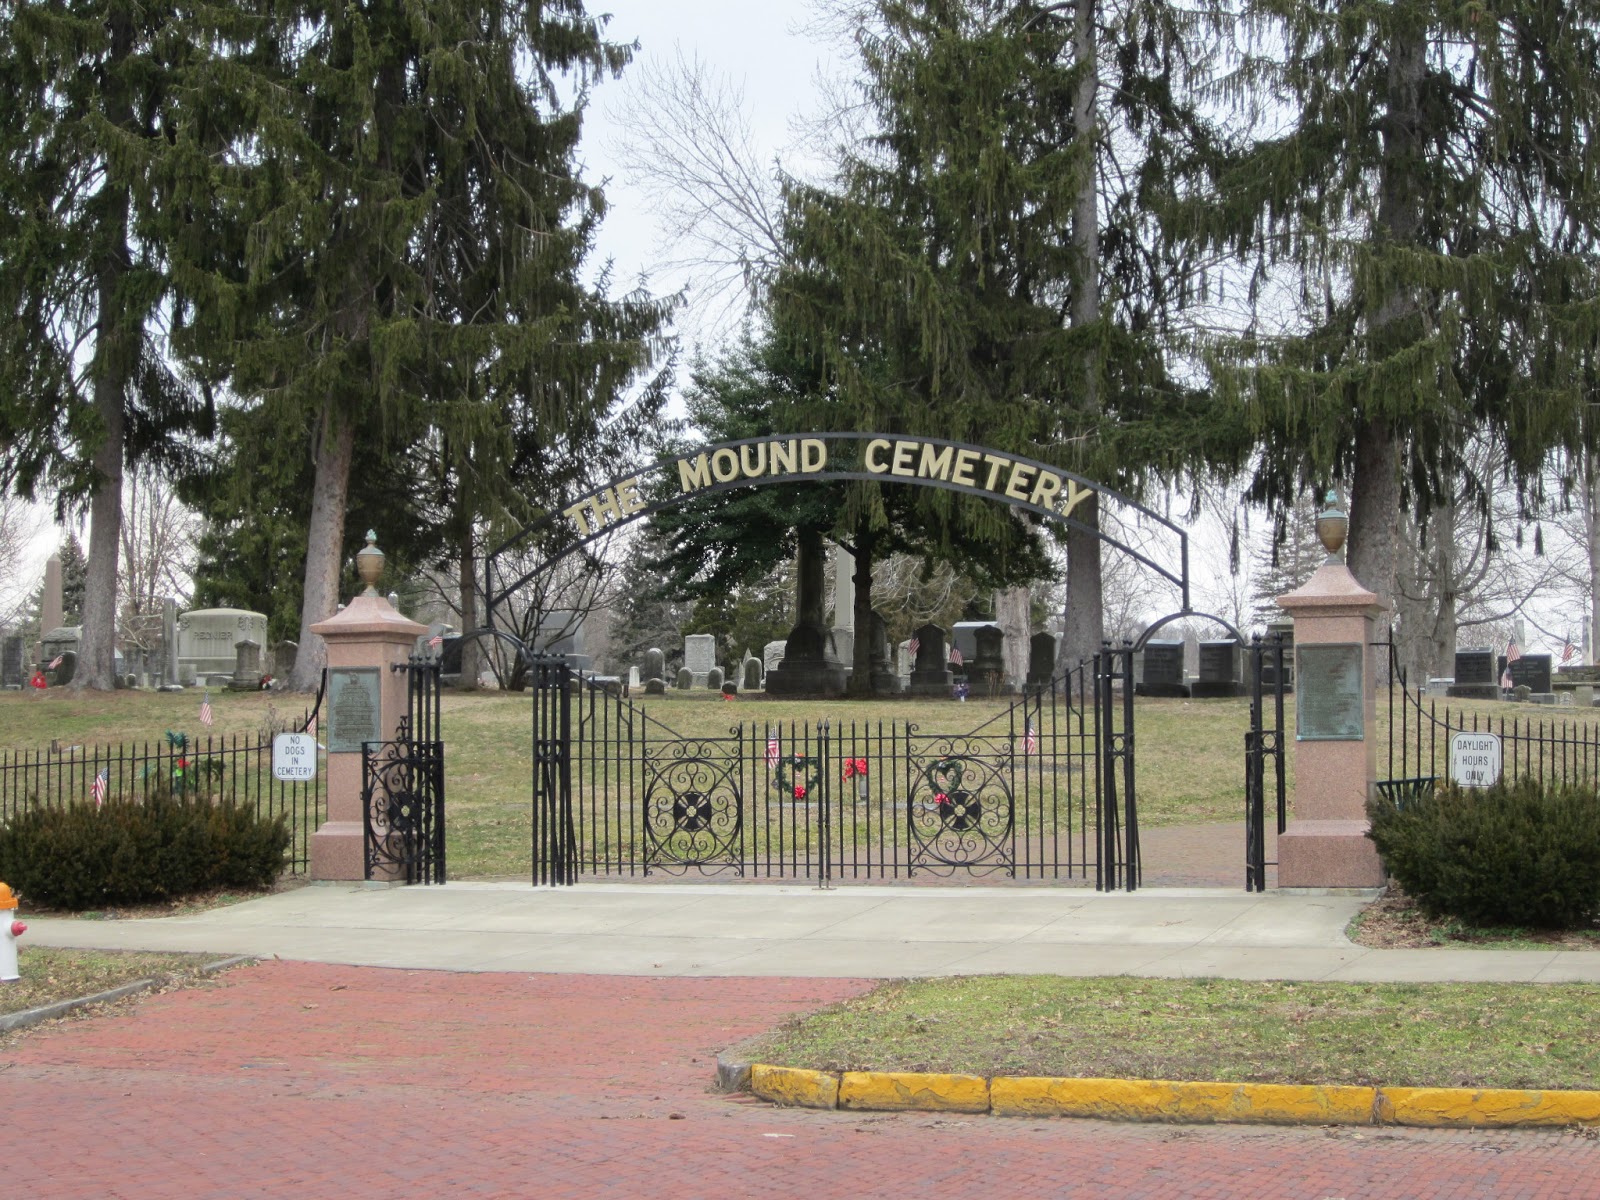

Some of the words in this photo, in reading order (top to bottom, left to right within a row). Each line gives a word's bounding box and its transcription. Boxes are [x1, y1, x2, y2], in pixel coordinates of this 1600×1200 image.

[562, 477, 647, 536] THE
[677, 437, 827, 493] MOUND
[864, 438, 1094, 518] CEMETERY
[290, 735, 300, 744] NO
[1457, 740, 1494, 750] DAYLIGHT
[285, 746, 305, 755] DOGS
[291, 757, 299, 765] IN
[1462, 755, 1488, 765] HOURS
[277, 767, 312, 776] CEMETERY
[1465, 770, 1485, 780] ONLY
